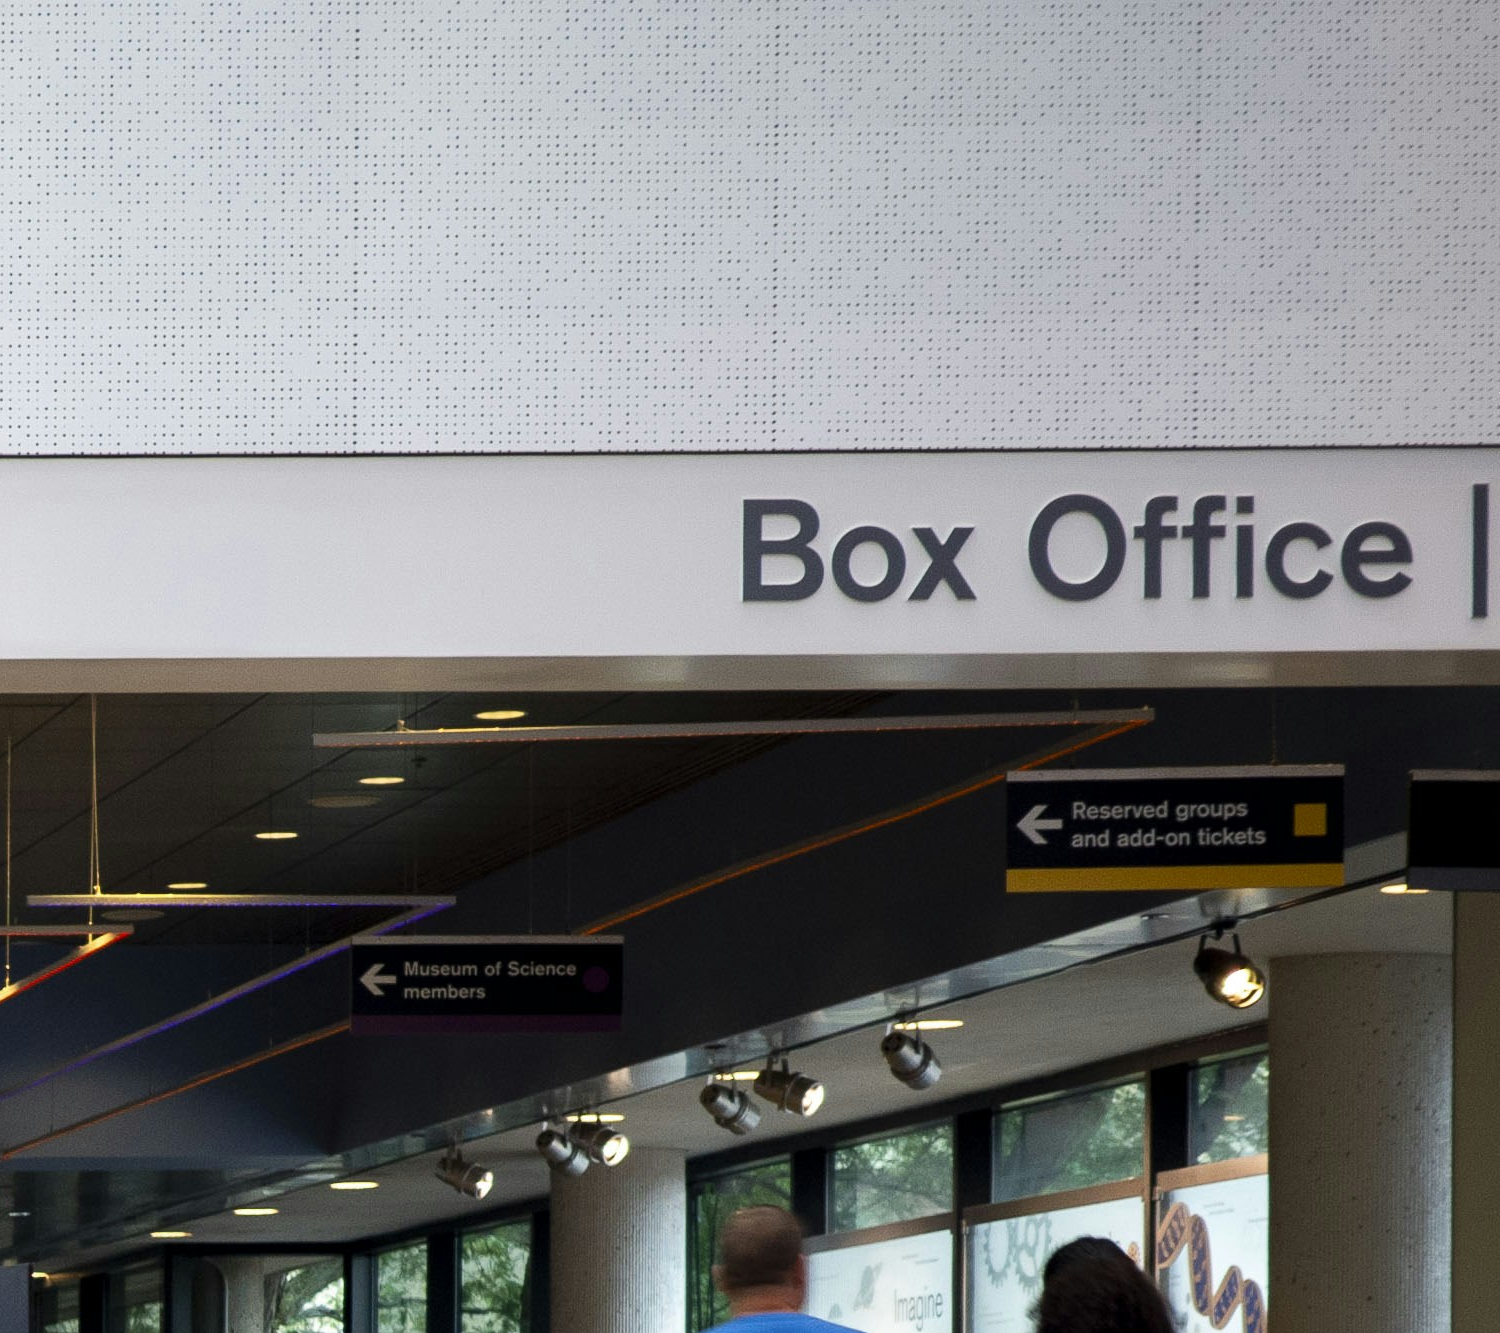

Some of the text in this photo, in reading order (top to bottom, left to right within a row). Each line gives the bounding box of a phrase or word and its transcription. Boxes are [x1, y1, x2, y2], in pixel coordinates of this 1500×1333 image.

[742, 493, 1414, 602] Box Office
[1071, 799, 1248, 821] Reserved groups
[1071, 826, 1267, 849] and add-on tickets
[403, 960, 577, 977] Museum of Science
[403, 983, 486, 1000] members
[893, 1286, 944, 1331] Imagine
